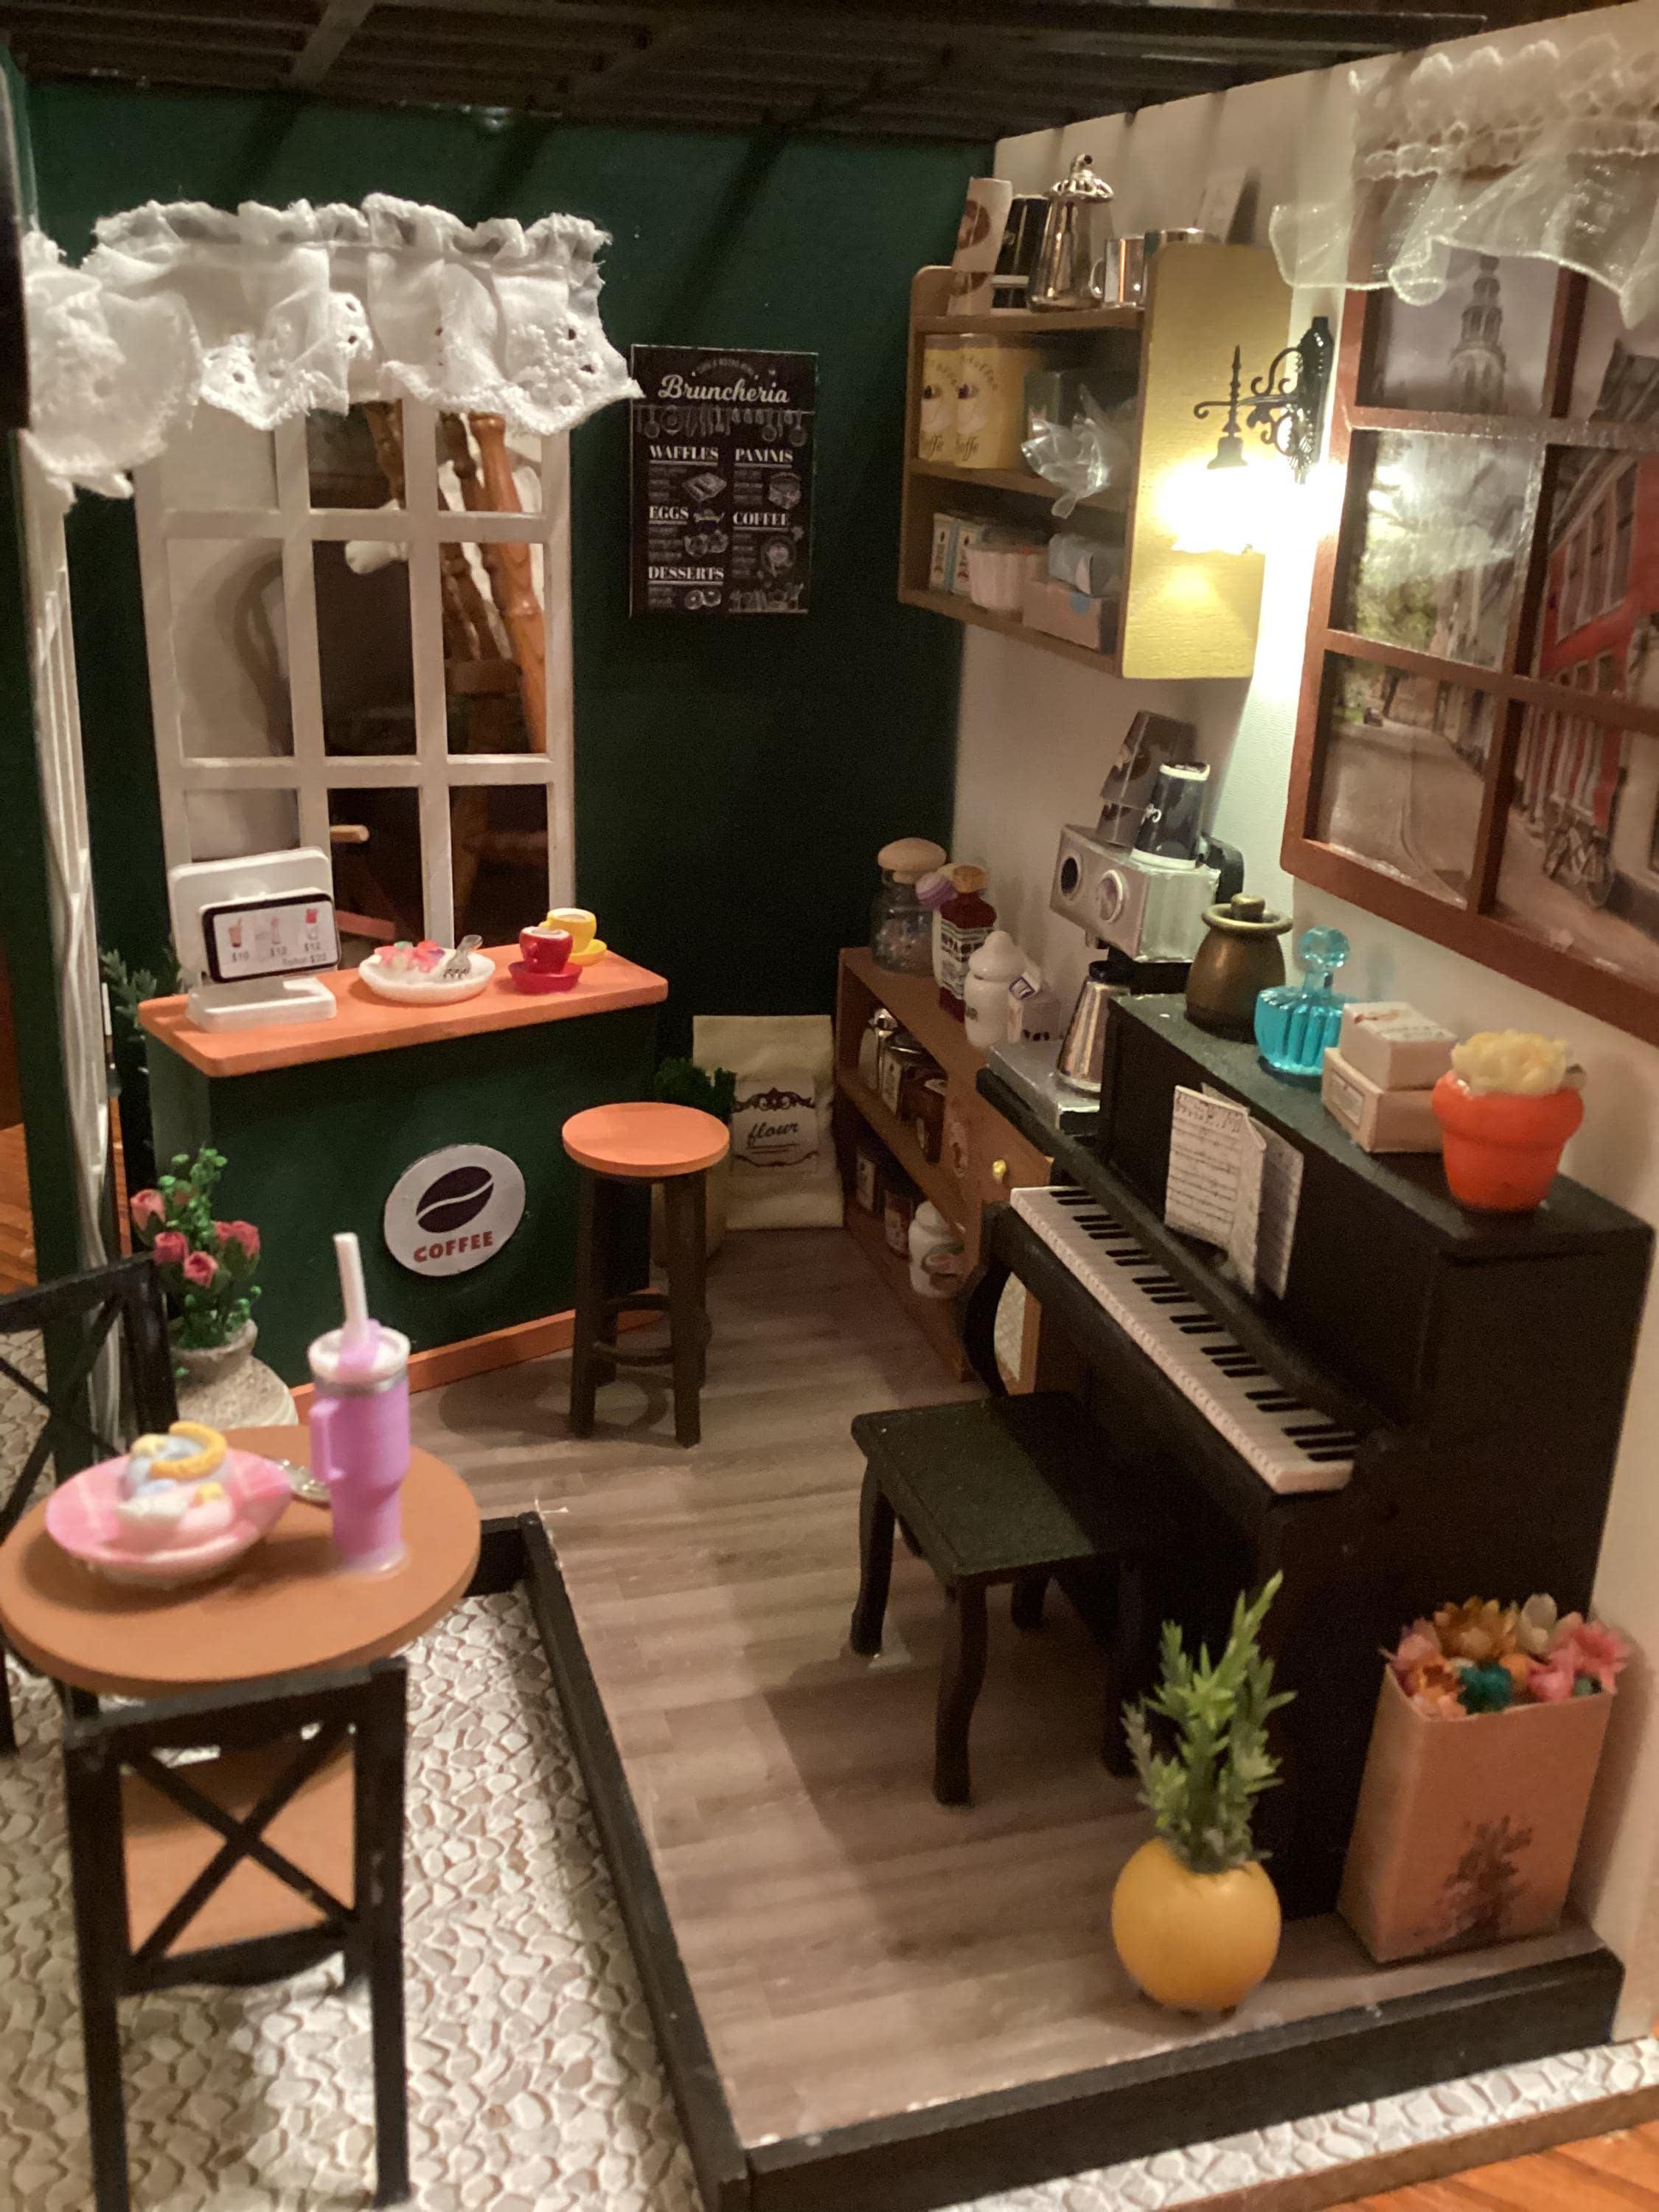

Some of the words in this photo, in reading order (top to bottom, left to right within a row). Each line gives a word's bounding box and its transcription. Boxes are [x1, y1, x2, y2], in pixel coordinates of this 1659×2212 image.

[658, 374, 790, 403] Bruncheria
[650, 445, 719, 459] WAFFLES
[735, 448, 793, 462] PANINIS
[649, 506, 689, 519] EGGS
[733, 512, 790, 526] COFFEE
[648, 566, 724, 580] DESSERTS
[747, 1121, 799, 1147] flour
[413, 1231, 494, 1262] COFFEE
